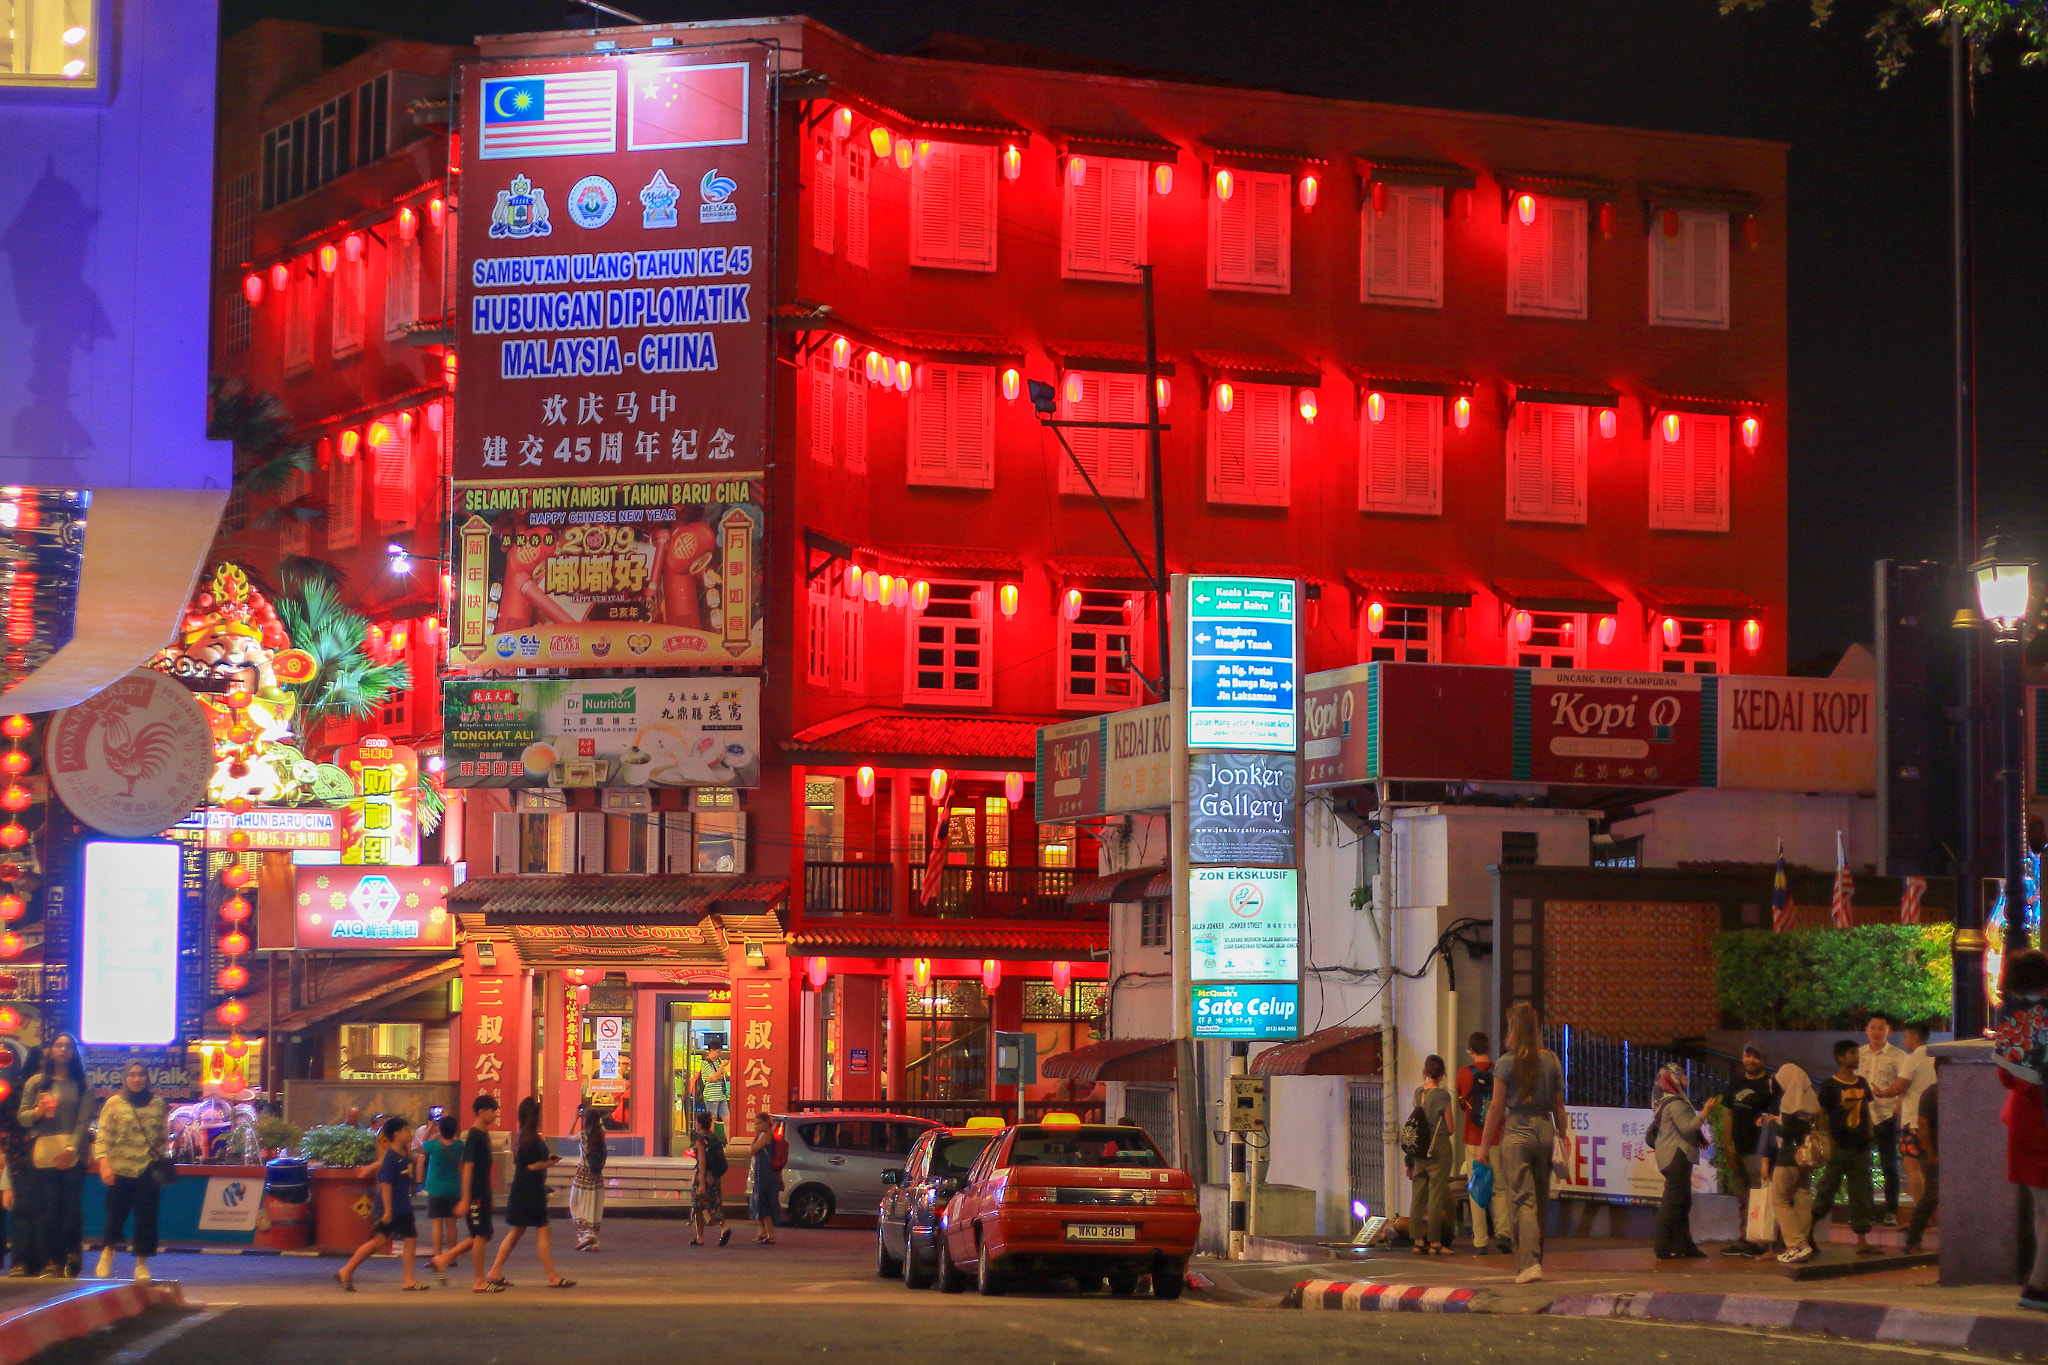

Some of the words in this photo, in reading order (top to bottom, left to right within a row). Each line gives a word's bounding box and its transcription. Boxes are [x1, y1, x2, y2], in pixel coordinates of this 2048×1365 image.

[702, 204, 735, 212] MELAKA
[474, 257, 570, 286] SAMBUTAN
[572, 251, 634, 281] ULANG
[636, 249, 698, 279] TAHUN
[700, 248, 726, 276] KE
[727, 246, 752, 275] 45
[473, 291, 603, 333] HUBUNGAN
[607, 285, 750, 327] DIPLOMATIK
[503, 336, 622, 378] MALAYSIA
[638, 333, 718, 373] CHINA
[541, 389, 676, 426] 欢庆马中
[482, 428, 736, 467] 建交45周年纪念
[465, 487, 529, 510] SELAMAT
[532, 484, 618, 509] MENYAMBUT
[622, 482, 669, 507] TAHUN
[672, 482, 712, 505] BARU
[715, 480, 750, 503] CINA
[530, 512, 566, 525] HAPPY
[568, 511, 617, 524] CHINESE
[619, 509, 643, 522] NEW
[646, 508, 677, 521] YEAR
[557, 524, 636, 554] 2019
[467, 539, 483, 635] 新年快乐
[729, 533, 744, 631] 万事如意
[608, 594, 625, 602] YEAR
[1215, 587, 1242, 597] Kuala
[1244, 588, 1275, 599] Lumpur
[609, 606, 639, 618] 己亥年
[1215, 600, 1242, 610] Johor
[1243, 601, 1269, 611] Bahru
[519, 635, 541, 645] G.L.
[1215, 626, 1258, 638] Tengkera
[550, 642, 580, 651] MELAKA
[1215, 639, 1246, 651] Masjid
[1246, 639, 1273, 650] Tanah
[1216, 665, 1231, 675] Jln
[1232, 665, 1247, 677] Kg.
[1248, 665, 1274, 676] Pantai
[1556, 674, 1595, 684] UNCANG
[1600, 675, 1622, 684] KOPI
[1627, 676, 1677, 687] CAMPURAN
[1216, 678, 1231, 688] Jln
[1232, 678, 1259, 690] Bunga
[1259, 679, 1278, 691] Raya
[567, 699, 581, 709] Dr
[585, 697, 631, 710] Nutrition
[1216, 691, 1231, 700] Jln
[1232, 691, 1277, 702] Laksamana
[1305, 692, 1338, 738] Kopi
[1551, 692, 1639, 735] Kopi
[1649, 695, 1681, 727] O
[1733, 689, 1804, 732] KEDAI
[1812, 691, 1869, 734] KOPI
[61, 703, 91, 766] JONKER
[452, 730, 511, 740] TONGKAT
[514, 730, 534, 740] ALI
[1114, 718, 1149, 760] KEDAI
[359, 748, 393, 759] 己亥年
[1055, 740, 1078, 778] Kopi
[1208, 763, 1283, 787] Jonker
[364, 768, 392, 864] 财神到
[1200, 793, 1283, 822] Gallery
[230, 812, 267, 829] TAHUN
[272, 813, 301, 830] BARU
[305, 814, 334, 830] CINA
[1200, 872, 1224, 880] ZON
[1228, 871, 1288, 880] EKSKLUSIF
[516, 925, 571, 938] San
[571, 925, 625, 938] Shu
[626, 925, 704, 944] Gong
[1198, 998, 1244, 1016] Sate
[1247, 997, 1296, 1020] Celup
[475, 978, 504, 1082] 三叔公
[744, 982, 775, 1088] 三叔公
[1102, 1226, 1125, 1238] 3481
